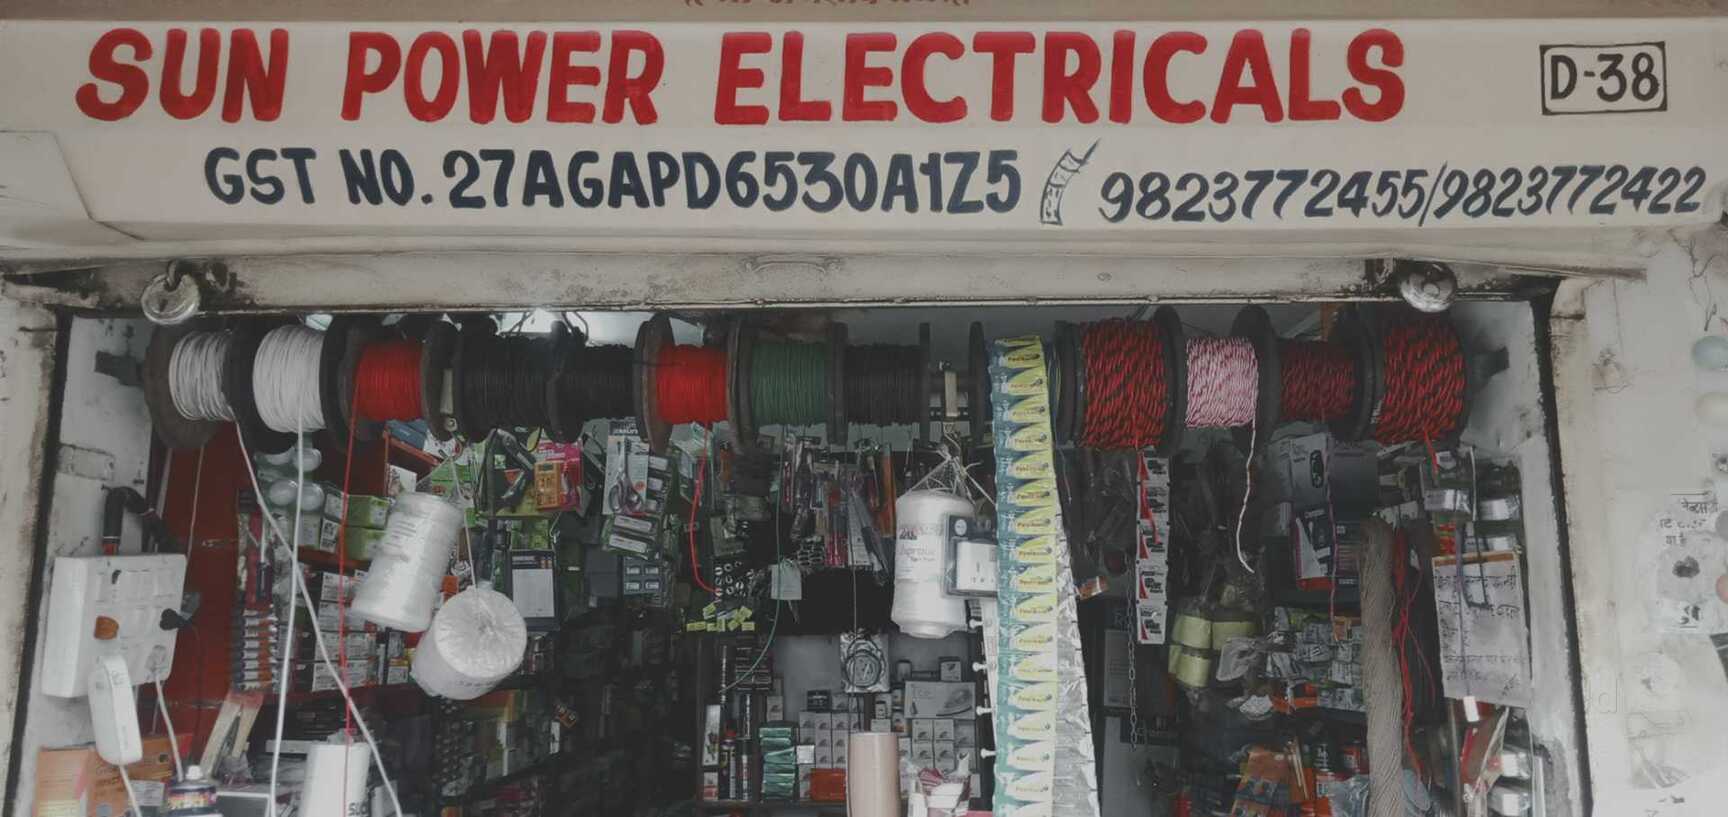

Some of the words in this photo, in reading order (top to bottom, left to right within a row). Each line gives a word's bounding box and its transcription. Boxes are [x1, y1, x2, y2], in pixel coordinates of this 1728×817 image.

[76, 28, 290, 123] SUN
[340, 30, 664, 125] POWER
[714, 28, 1406, 126] ELECTRICALS
[1550, 51, 1660, 103] D-38
[204, 147, 316, 206] GST
[338, 148, 434, 207] NO.
[443, 149, 1021, 215] 27AGAPD6530A1Z5
